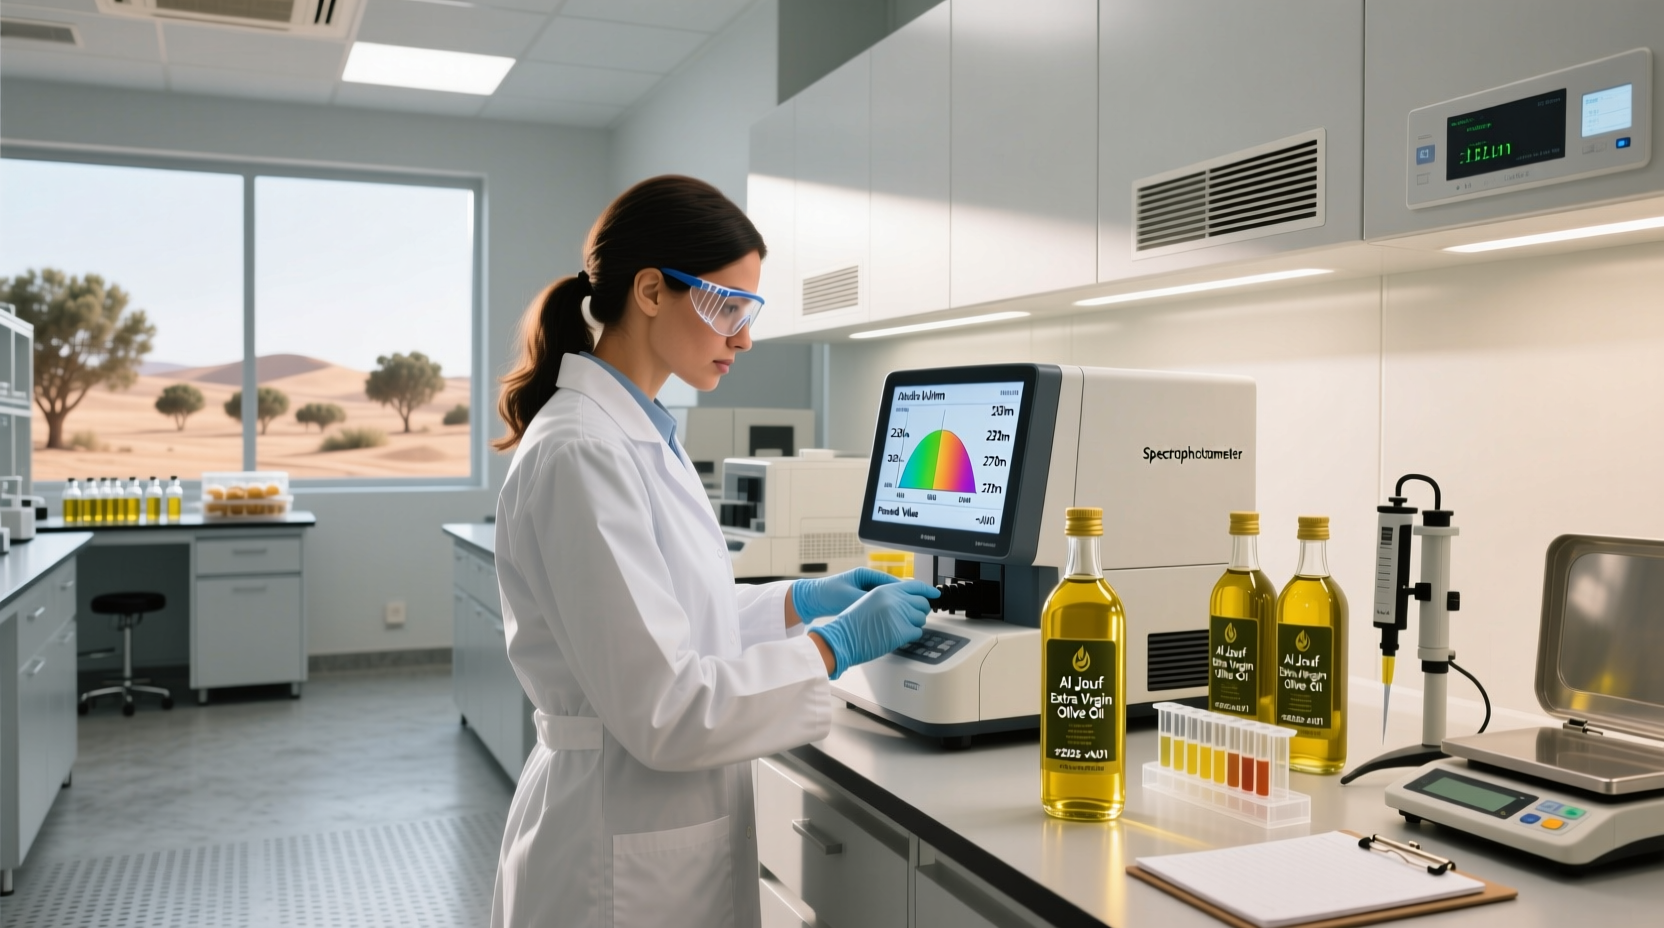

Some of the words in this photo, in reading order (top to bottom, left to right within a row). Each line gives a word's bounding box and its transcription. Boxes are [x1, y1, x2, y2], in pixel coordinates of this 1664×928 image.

[1059, 675, 1072, 689] Al
[1074, 675, 1105, 691] Jouf
[1050, 692, 1078, 704] Extra
